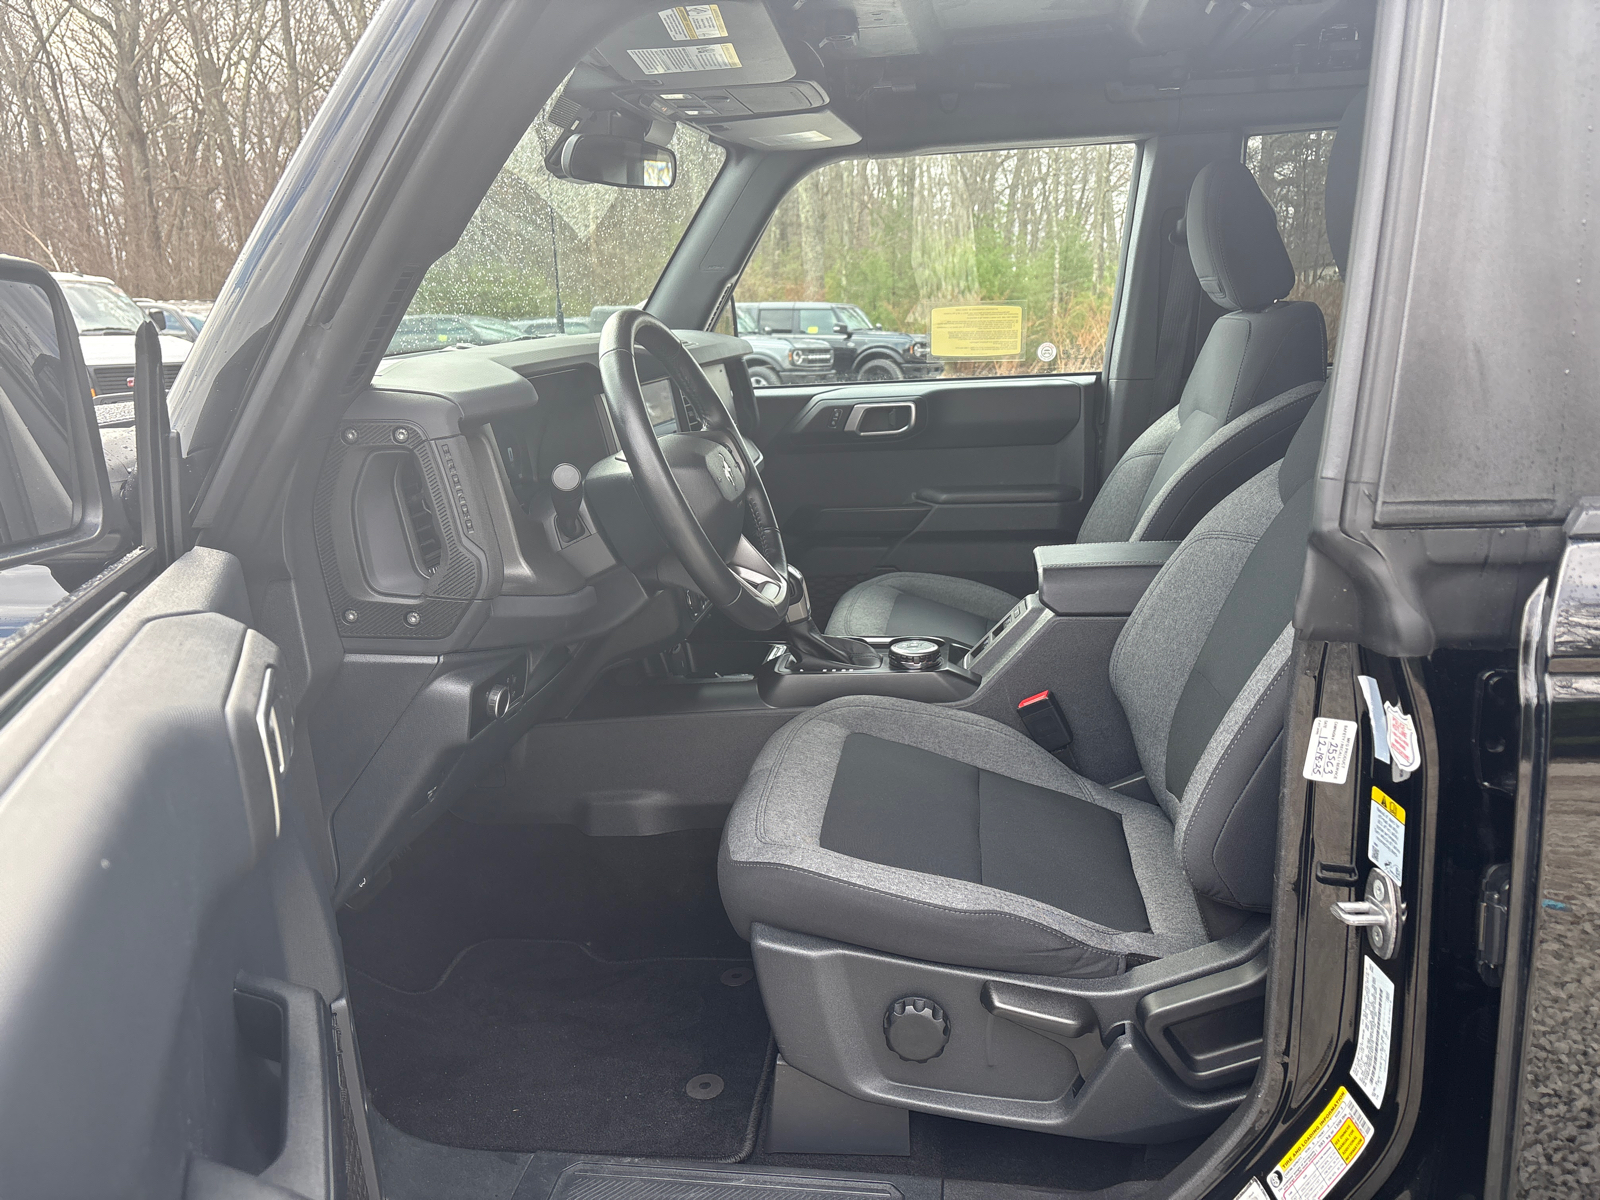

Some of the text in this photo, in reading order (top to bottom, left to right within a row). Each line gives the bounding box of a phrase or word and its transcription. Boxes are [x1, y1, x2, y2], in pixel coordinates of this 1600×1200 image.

[1280, 1156, 1293, 1169] TIRE
[1291, 1145, 1302, 1157] AND
[1300, 1125, 1320, 1147] LOADING
[1318, 1090, 1345, 1126] INFORMATION
